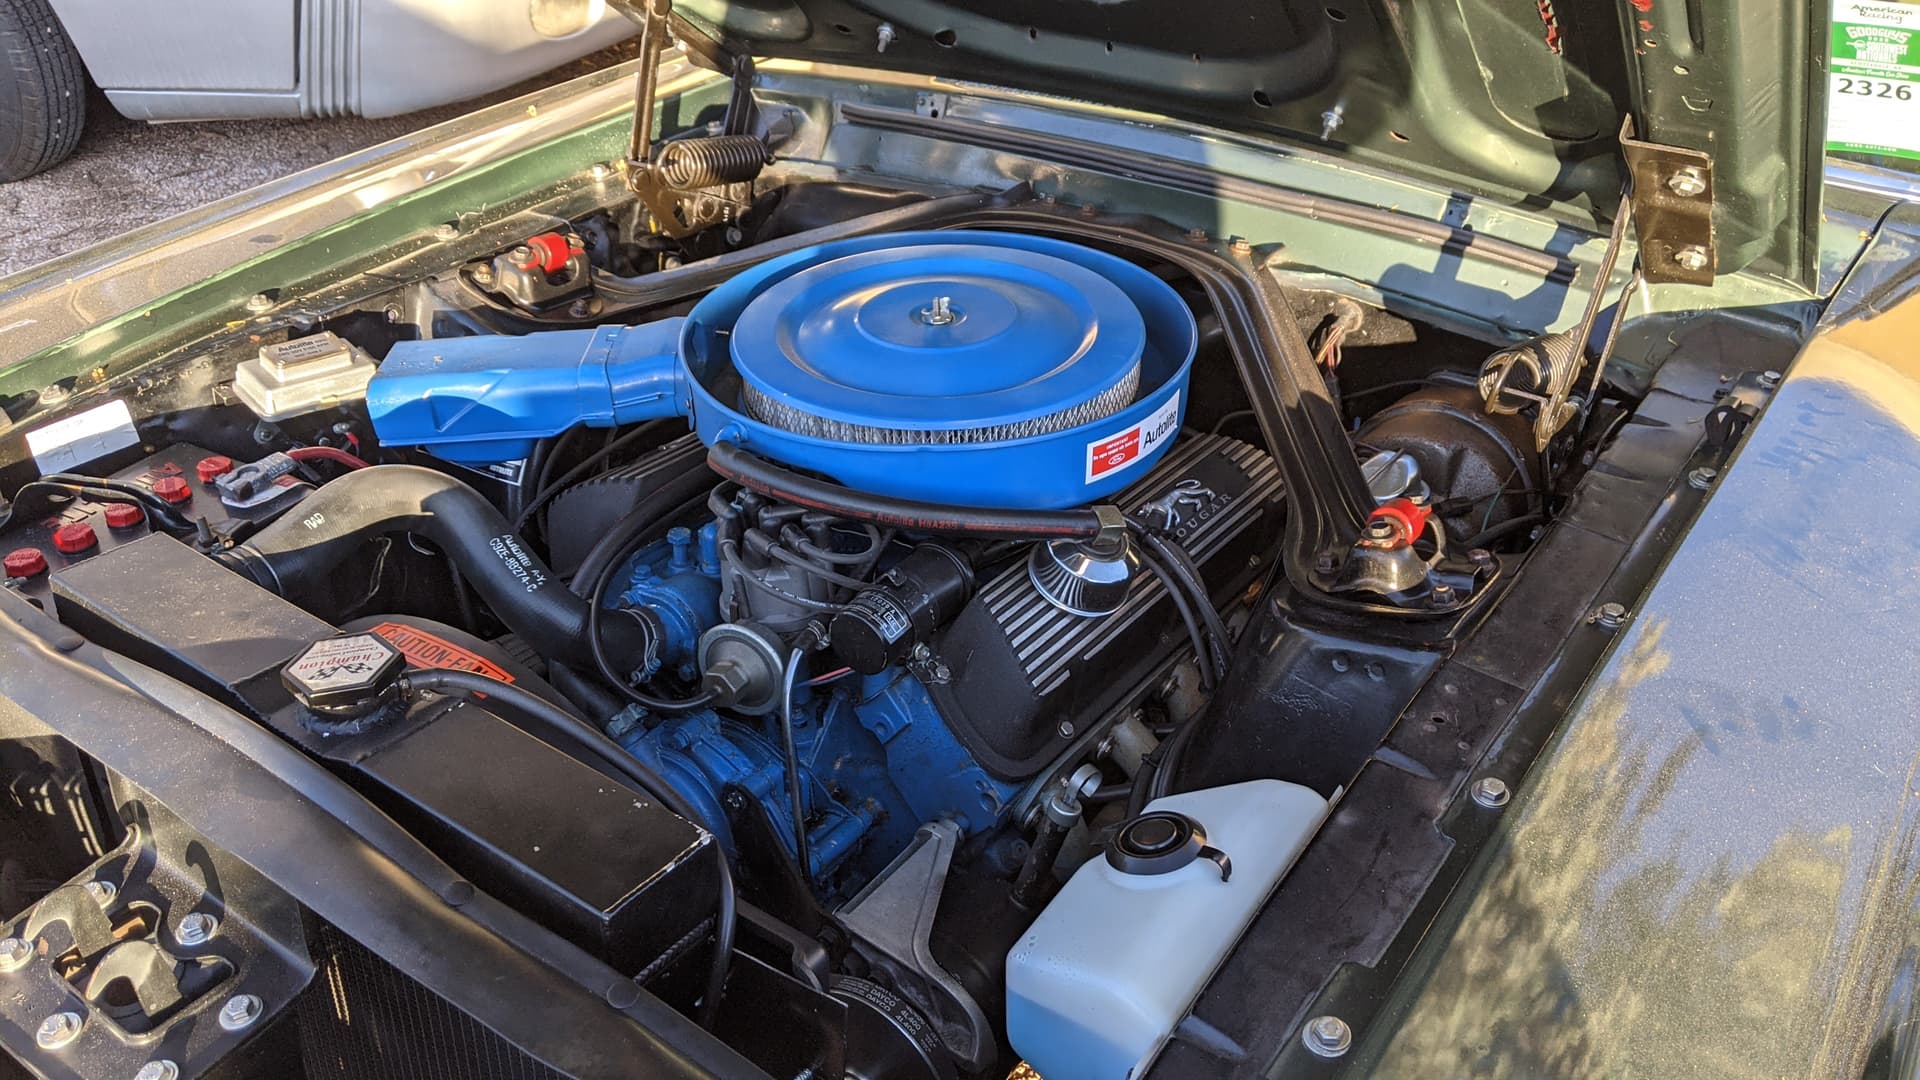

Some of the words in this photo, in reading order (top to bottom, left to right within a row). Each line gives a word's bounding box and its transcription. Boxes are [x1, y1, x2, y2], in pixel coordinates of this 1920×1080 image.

[1851, 4, 1913, 16] American
[1859, 11, 1903, 25] Racing
[1845, 26, 1912, 44] GOODGUYS
[1838, 77, 1912, 101] 2326
[1143, 410, 1178, 449] Autolite
[303, 512, 326, 530] RAD
[1176, 493, 1232, 538] OUGAR
[502, 534, 532, 567] Autolite
[299, 652, 384, 671] Champion
[865, 993, 892, 1012] DAYCO
[870, 988, 897, 1007] DAYCO
